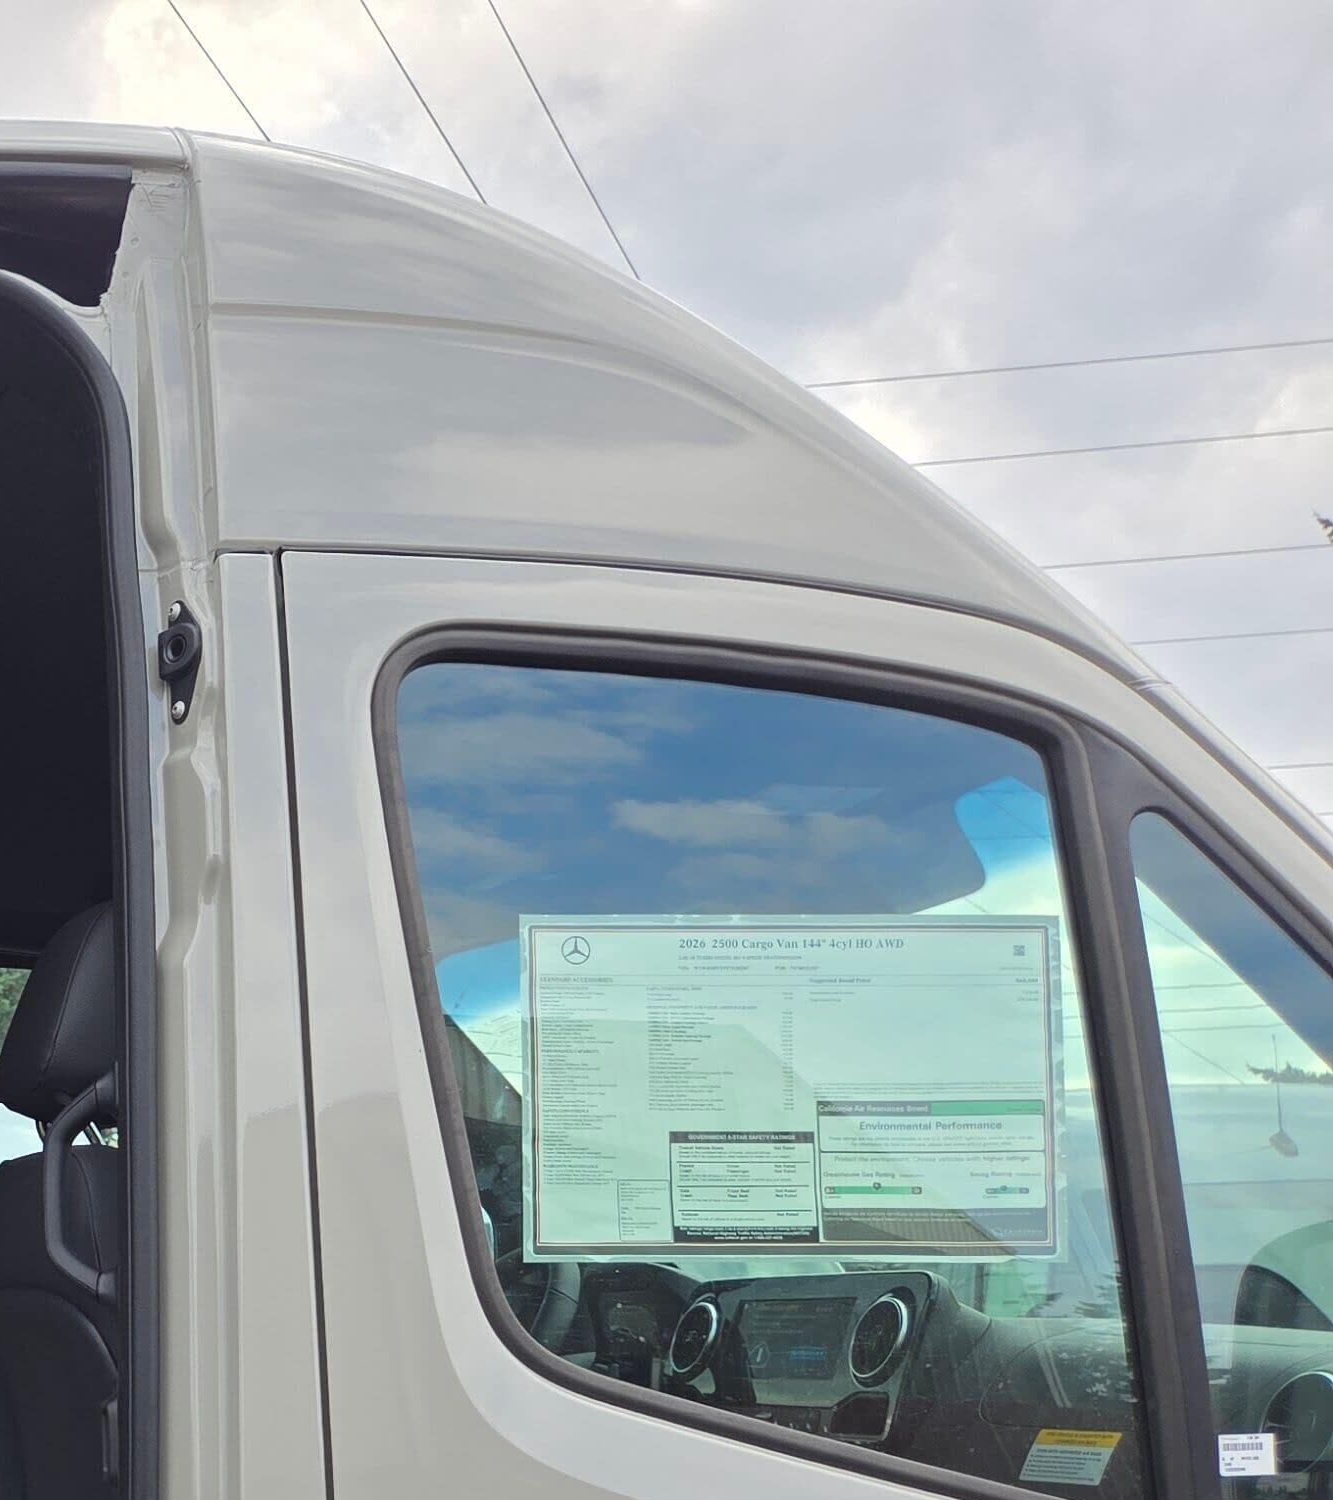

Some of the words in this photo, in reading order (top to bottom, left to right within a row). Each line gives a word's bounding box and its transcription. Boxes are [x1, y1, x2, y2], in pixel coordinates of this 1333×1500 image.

[679, 939, 706, 949] 2026
[712, 939, 738, 949] 2500
[741, 939, 773, 951] Cargo
[776, 939, 798, 949] Van
[829, 939, 852, 951] 4cyl
[856, 939, 873, 949] HO
[876, 939, 905, 949] AWD
[859, 1121, 932, 1131] Environmental
[935, 1121, 1003, 1130] Performance
